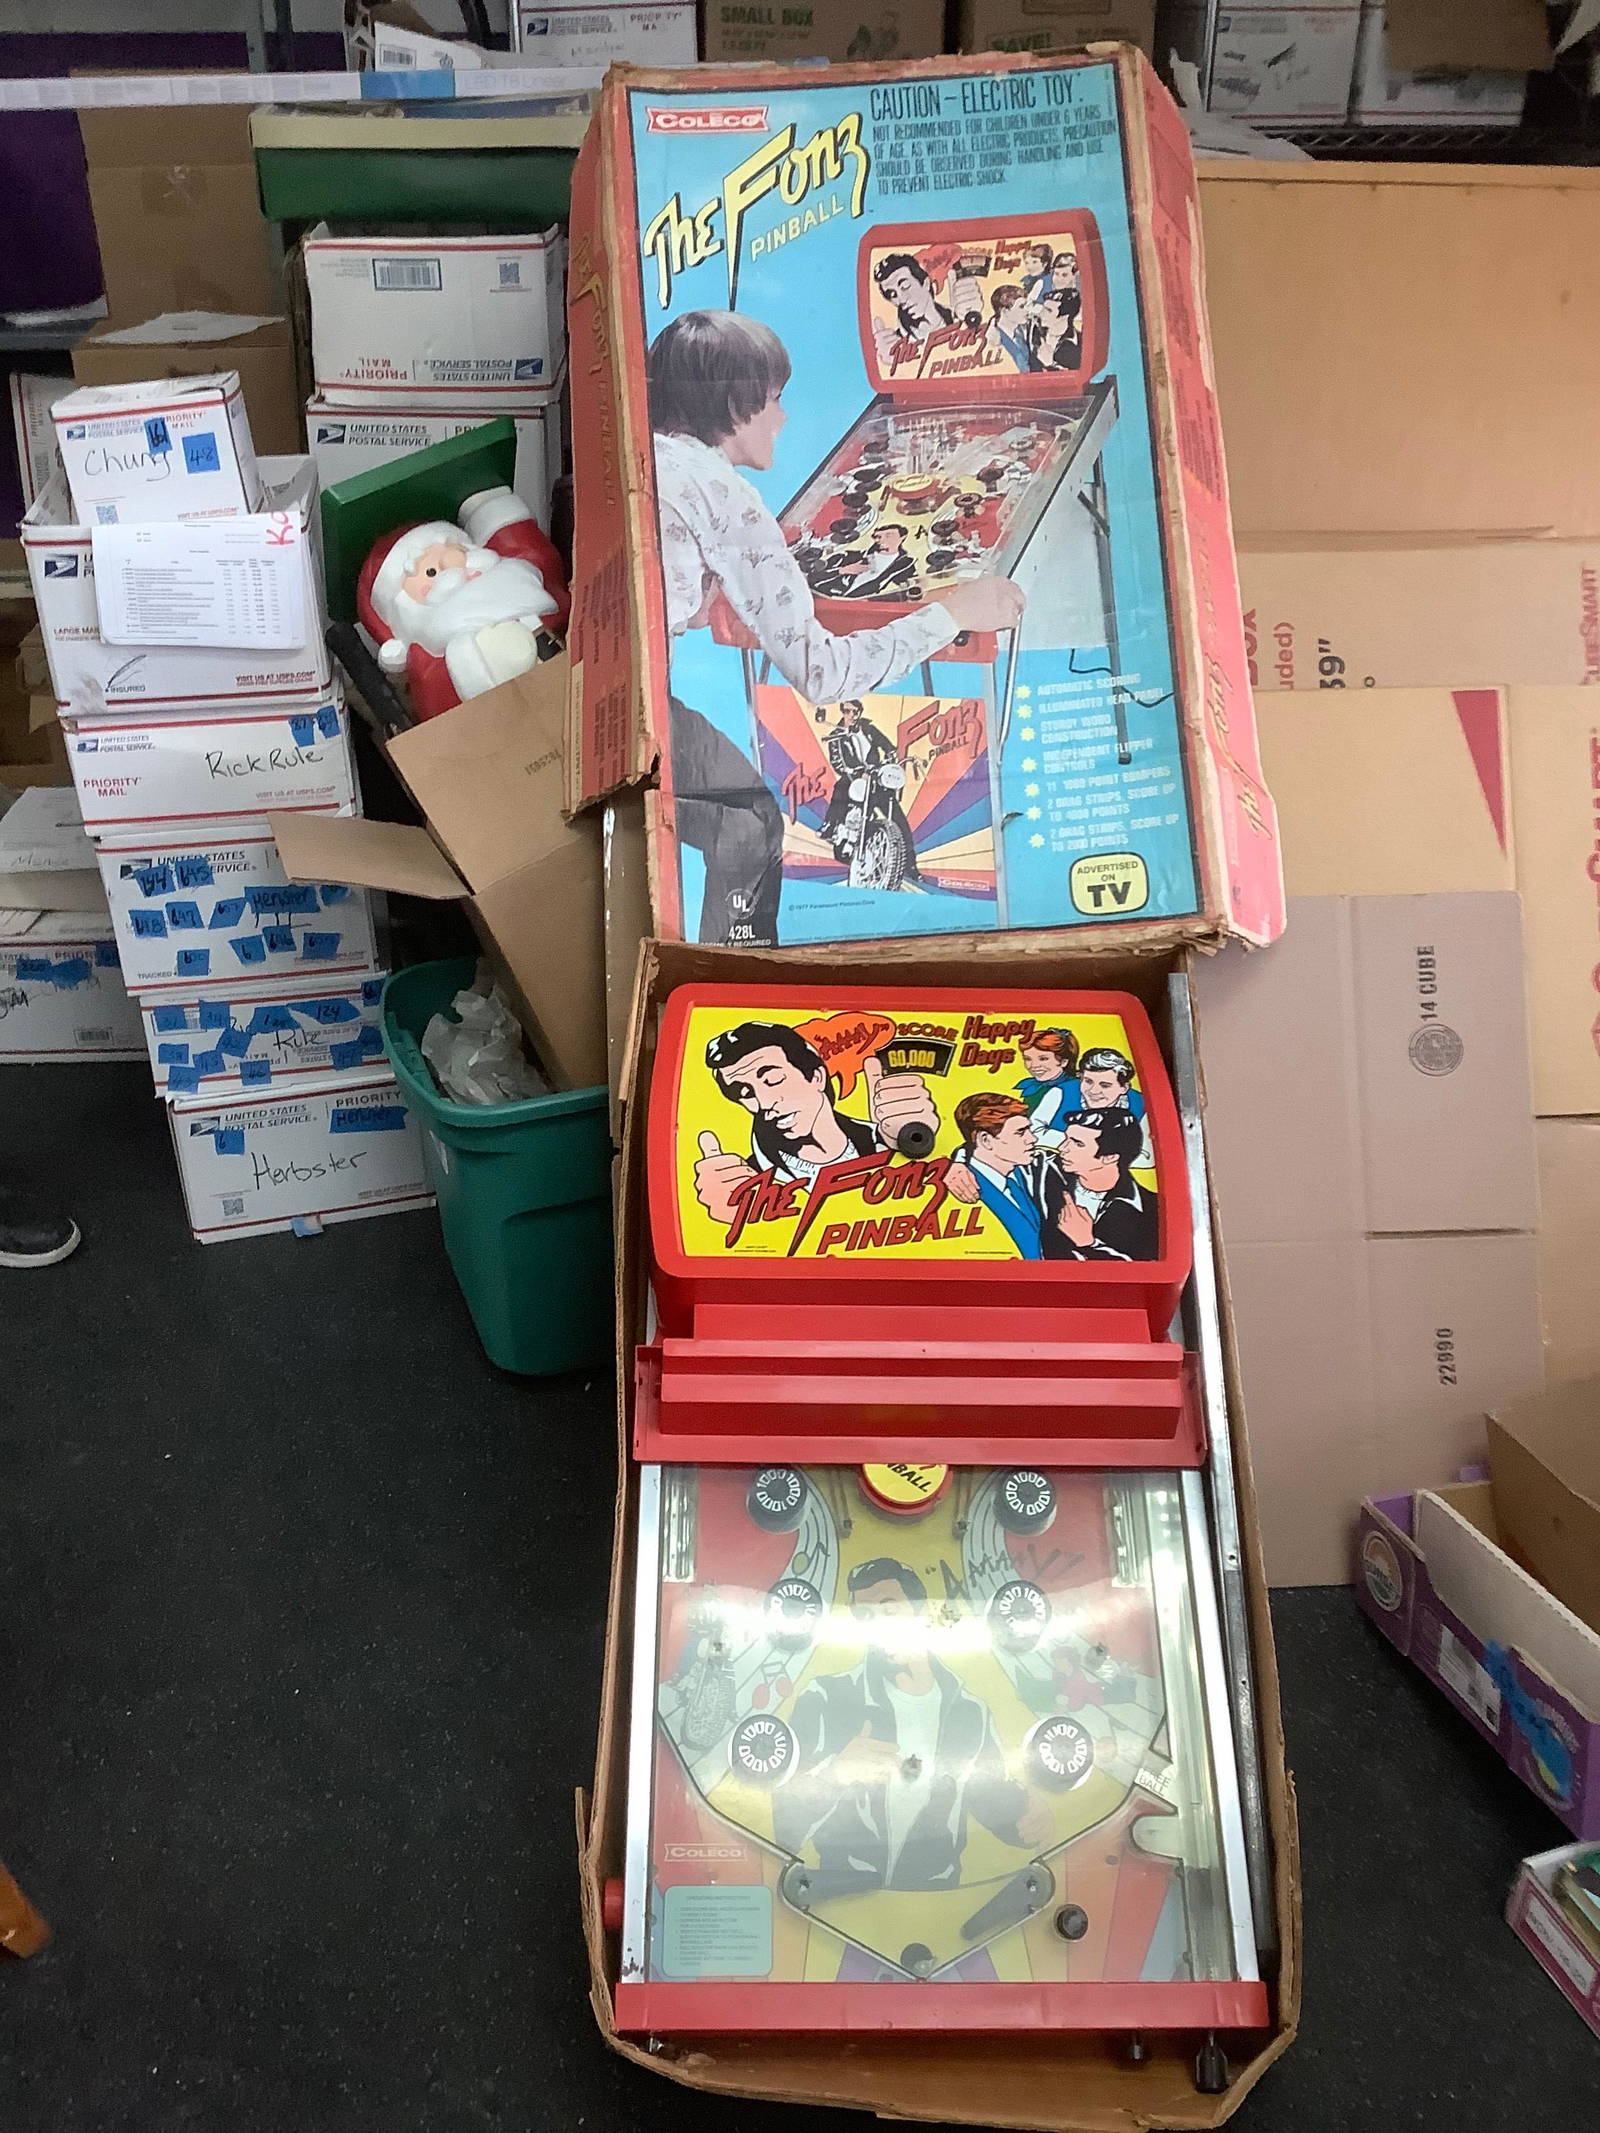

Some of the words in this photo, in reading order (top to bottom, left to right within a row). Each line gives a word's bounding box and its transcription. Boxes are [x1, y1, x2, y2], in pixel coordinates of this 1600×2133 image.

[870, 84, 942, 121] CAUTION
[961, 74, 1037, 115] ELECTRIC
[873, 125, 890, 142] NOT
[895, 120, 961, 140] RECOMMENDED
[965, 118, 983, 134] FOR
[986, 114, 1028, 132] CHILDREN
[1031, 111, 1060, 128] UNDER
[1074, 104, 1101, 121] YEARS
[927, 139, 948, 156] WITH
[876, 159, 911, 177] SHOULD
[892, 175, 930, 193] PREVENT
[723, 110, 873, 311] Fonz
[750, 193, 846, 261] PINBALL
[360, 357, 392, 368] MAIL
[474, 359, 513, 369] POSTAL
[929, 348, 1004, 378] PINBALL
[344, 368, 408, 381] PRIORITY
[433, 372, 470, 381] STATES
[474, 372, 511, 381] UNITED
[166, 412, 202, 422] RIORITY
[350, 424, 389, 434] UNITED
[391, 424, 427, 434] STATES
[348, 436, 386, 446] POSTAL
[1037, 679, 1094, 697] AUTOMATIC
[897, 700, 984, 764] Fonz
[1041, 726, 1118, 744] CONSTRUCTION
[1044, 759, 1096, 774] CONTROLS
[83, 777, 140, 788] PRIORITY
[1088, 774, 1119, 788] POINT
[97, 788, 128, 798] MAIL
[781, 763, 828, 826] The
[1050, 811, 1062, 822] TO
[1091, 803, 1130, 818] POINTS
[1091, 834, 1129, 848] POINTS
[211, 864, 251, 874] ERVICE
[1077, 860, 1139, 875] ADVERTISED
[1101, 873, 1116, 882] ON
[1087, 881, 1132, 908] TV
[728, 925, 756, 940] 428L
[1416, 945, 1436, 996] CUBE
[1419, 1001, 1438, 1021] 14
[898, 1022, 959, 1041] SCORE
[962, 1015, 1037, 1044] Happy
[888, 1048, 936, 1069] 60,000
[958, 1042, 1017, 1075] Days
[336, 1091, 401, 1108] PRIORITY
[225, 1110, 267, 1123] UNITED
[268, 1104, 307, 1117] STATES
[725, 1169, 801, 1249] The
[787, 1150, 951, 1257] Fonz
[816, 1206, 985, 1256] PINBALL
[1439, 1327, 1457, 1386] 22990
[670, 1847, 742, 1858] COLECO
